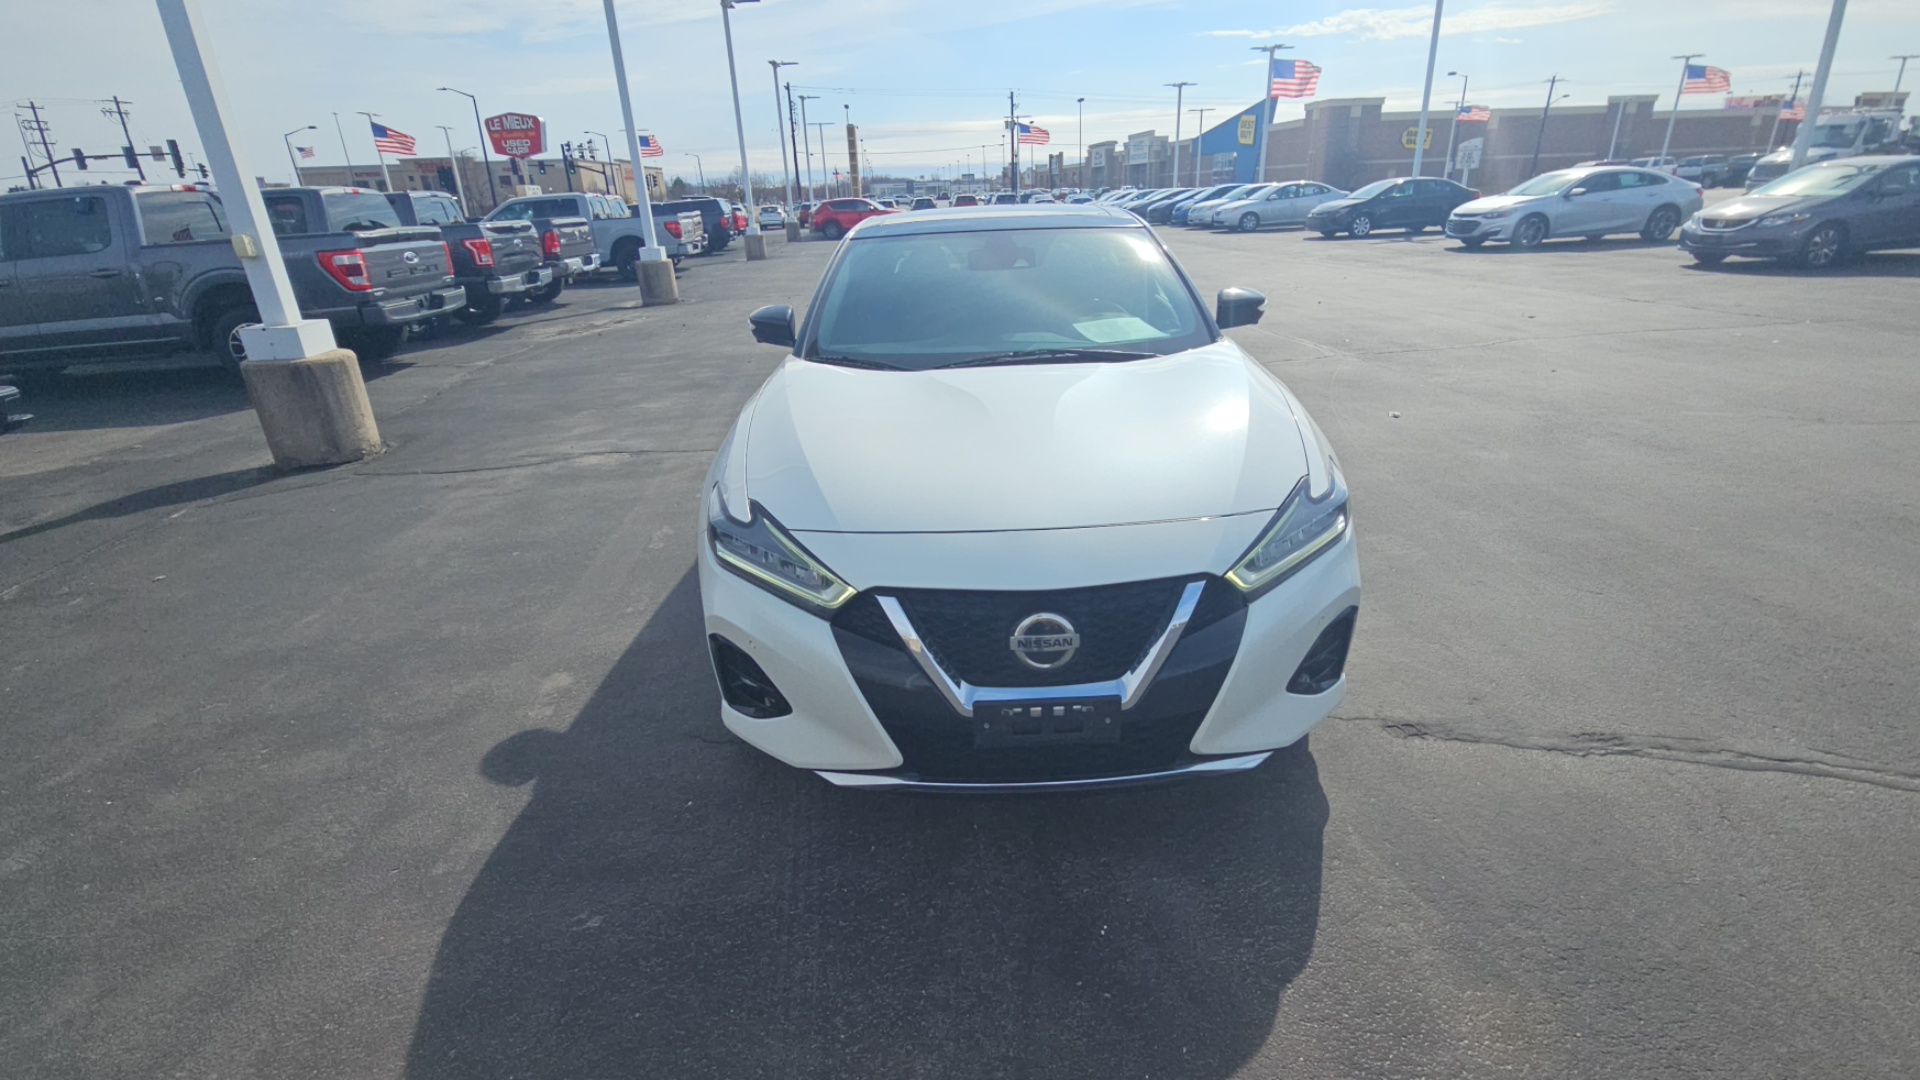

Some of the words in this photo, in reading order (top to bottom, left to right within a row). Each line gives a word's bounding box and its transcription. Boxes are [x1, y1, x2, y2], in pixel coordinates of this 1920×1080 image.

[488, 119, 501, 131] LE
[502, 115, 535, 130] MIEUX
[501, 139, 531, 147] USED
[506, 147, 529, 155] CARS
[1017, 637, 1073, 649] NISSAN
